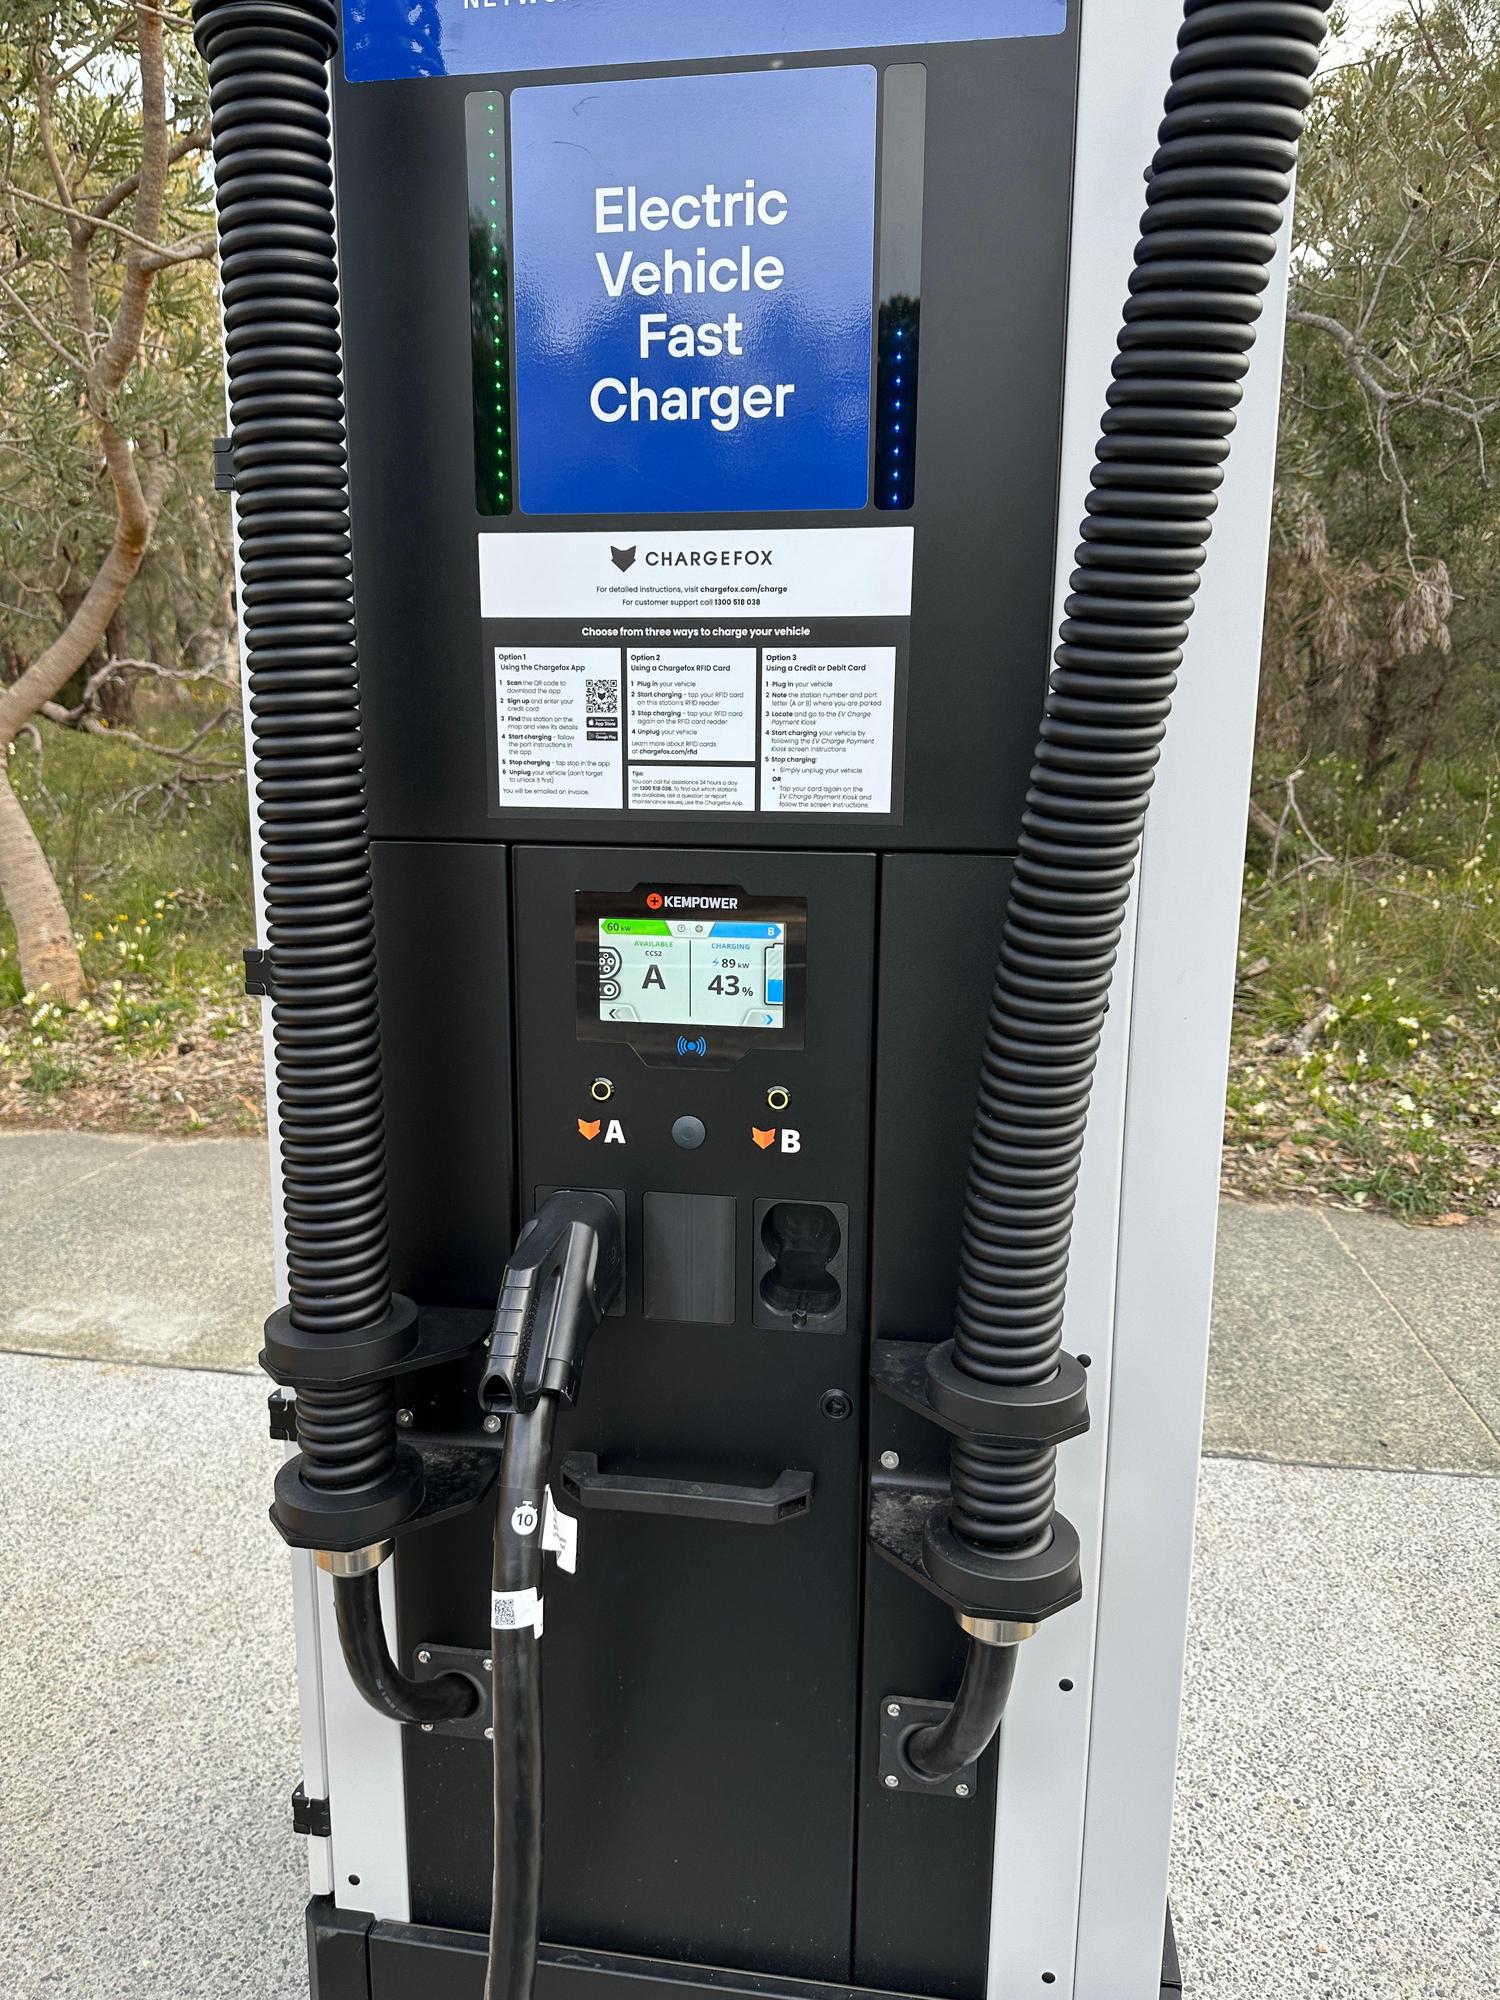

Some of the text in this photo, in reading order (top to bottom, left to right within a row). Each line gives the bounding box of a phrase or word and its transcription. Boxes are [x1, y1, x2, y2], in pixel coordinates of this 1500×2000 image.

[595, 180, 788, 234] Electric
[596, 245, 784, 298] Vehicle
[640, 312, 743, 359] Fast
[590, 376, 794, 432] Charger
[646, 551, 773, 566] CHARGEFOX
[640, 586, 683, 594] instructions,
[700, 585, 787, 594] chargefox.com/charge
[582, 626, 810, 638] Choose from three ways to charge your vehicle
[766, 654, 791, 662] Option
[501, 664, 520, 672] Using
[534, 664, 569, 672] Chargefox
[631, 665, 650, 673] Using
[658, 665, 695, 673] Chargefox
[766, 665, 786, 673] Using
[639, 748, 697, 756] chargefox.com/rfid
[664, 895, 738, 909] KEMPOWER
[607, 923, 619, 932] 60
[634, 940, 673, 948] AVAILABLE
[722, 958, 735, 968] 89
[642, 964, 666, 990] A
[708, 975, 753, 996] 43 %
[604, 1120, 626, 1143] A
[781, 1129, 800, 1153] B
[517, 1514, 533, 1526] 10
